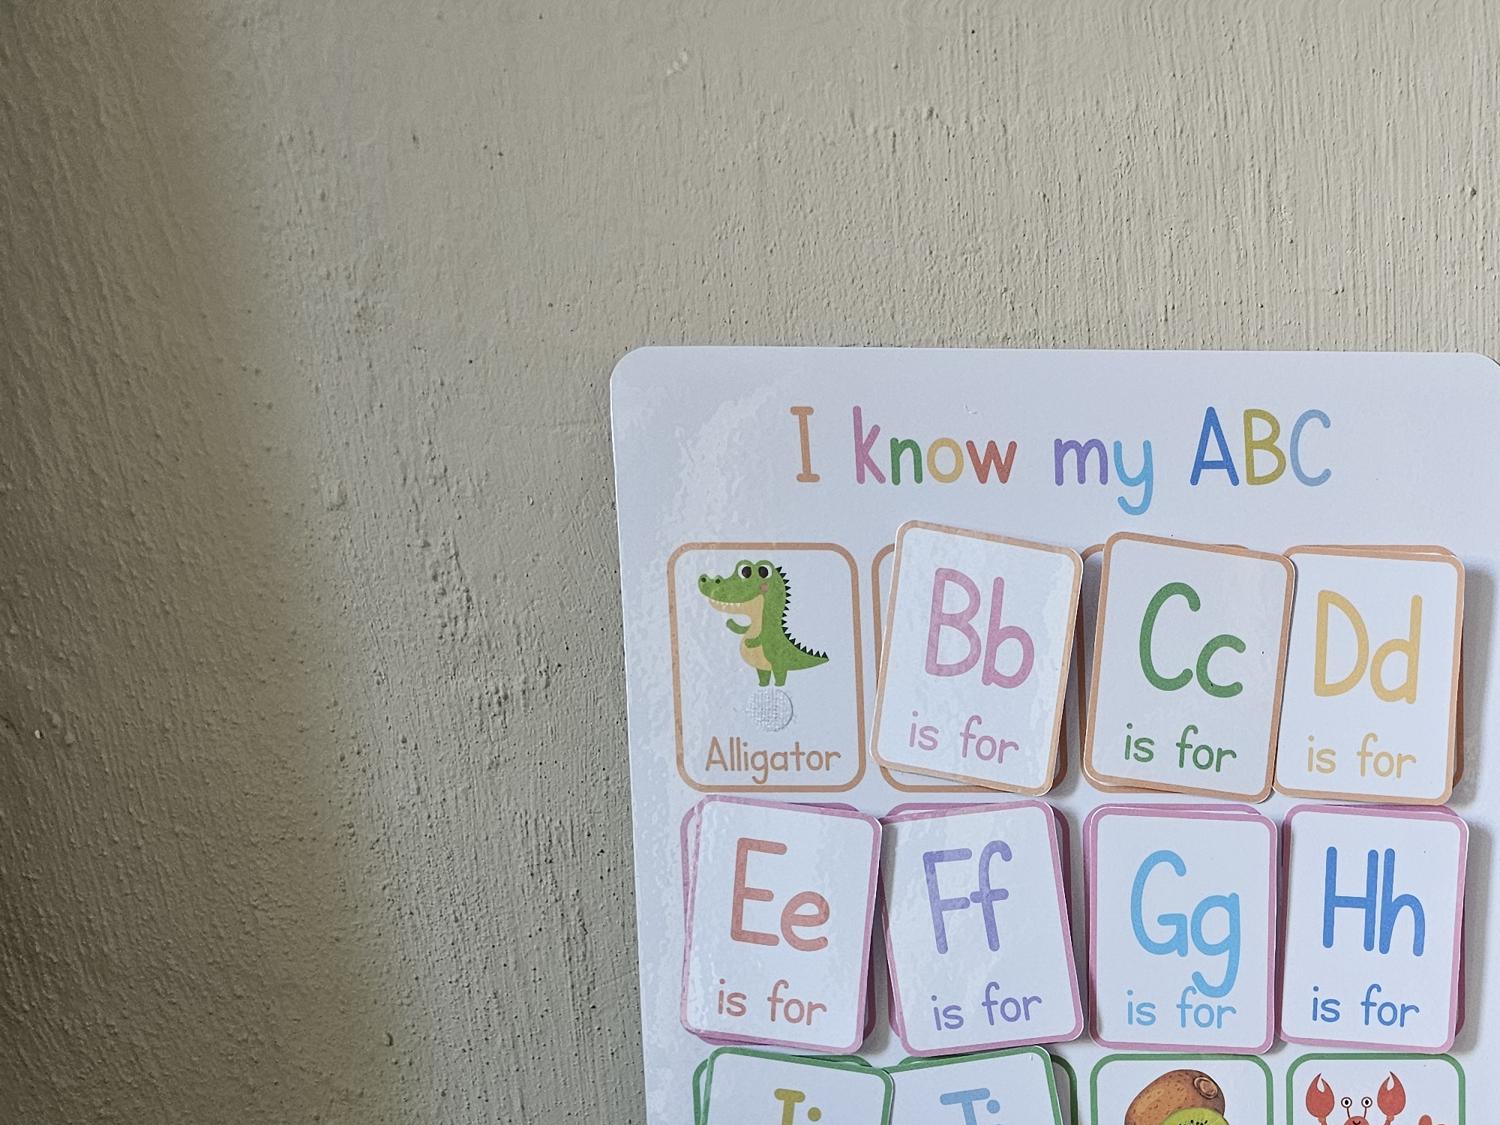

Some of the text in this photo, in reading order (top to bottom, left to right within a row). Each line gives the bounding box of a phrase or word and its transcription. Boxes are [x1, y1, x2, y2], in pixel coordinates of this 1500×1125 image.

[790, 406, 1331, 515] I know my ABC
[925, 568, 1034, 688] Bb
[1139, 582, 1246, 698] Cc
[1314, 590, 1422, 704] Dd
[705, 738, 841, 785] Alligator
[910, 711, 1019, 764] is for
[1125, 723, 1237, 772] is for
[1307, 732, 1417, 779] is for
[730, 837, 830, 952] Ee
[923, 840, 1012, 954] Ff
[1127, 850, 1241, 998] Gg
[1323, 847, 1425, 956] Hh
[718, 979, 827, 1025] is for
[931, 982, 1042, 1030] is for
[1127, 986, 1236, 1029] is for
[1313, 984, 1419, 1027] is for
